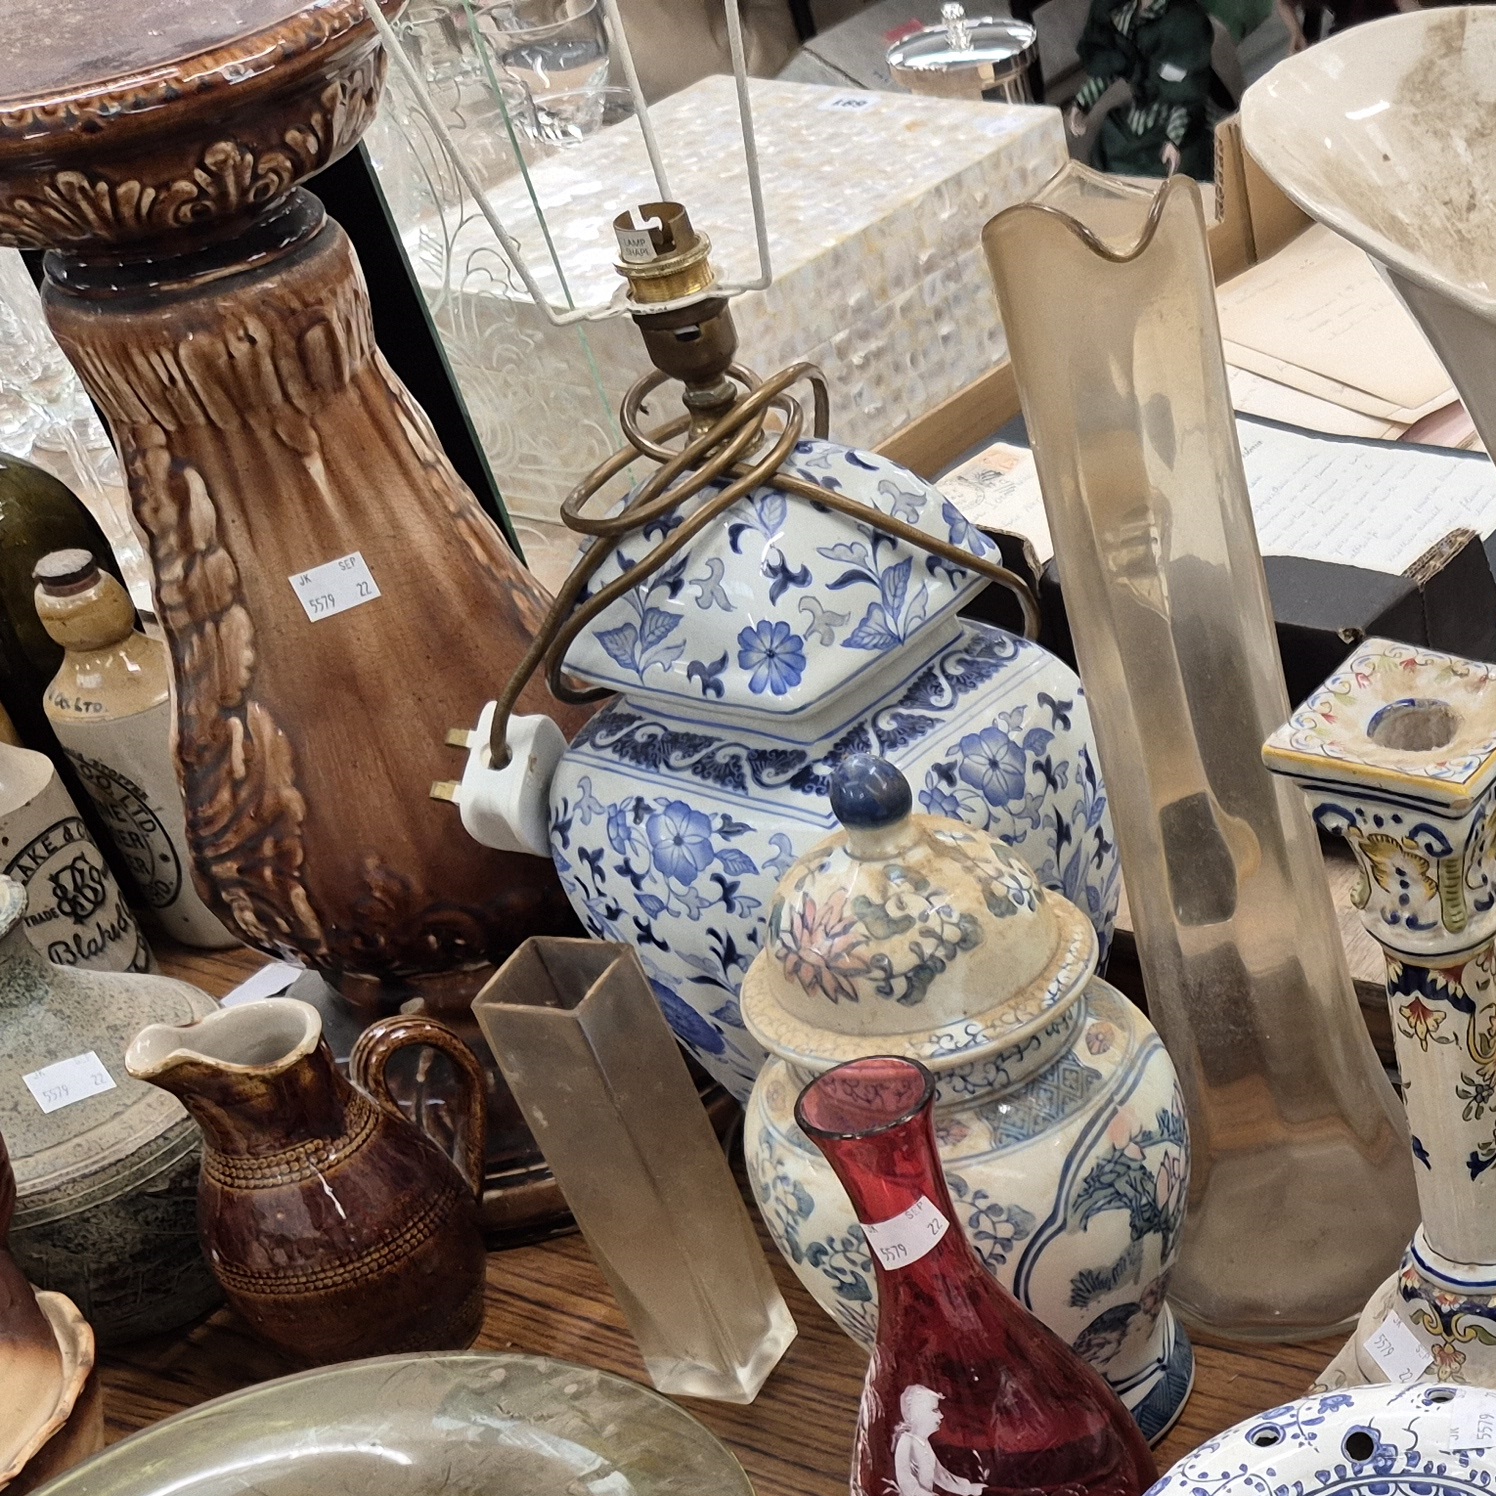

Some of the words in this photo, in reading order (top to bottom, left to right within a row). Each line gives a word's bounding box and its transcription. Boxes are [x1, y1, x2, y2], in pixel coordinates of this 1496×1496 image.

[299, 574, 313, 587] JK
[338, 556, 356, 571] SEP
[309, 593, 336, 613] 5579
[356, 581, 372, 597] 22
[17, 837, 58, 886] AKE
[24, 906, 60, 929] TRADE
[42, 1084, 69, 1103] 5579
[90, 1073, 106, 1086] 22
[905, 1201, 924, 1220] SEP
[880, 1243, 908, 1261] 5579
[927, 1217, 943, 1236] 22
[1373, 1333, 1395, 1358] 5579
[1398, 1367, 1414, 1383] 22
[1449, 1426, 1460, 1441] JK
[1476, 1413, 1495, 1440] 5579
